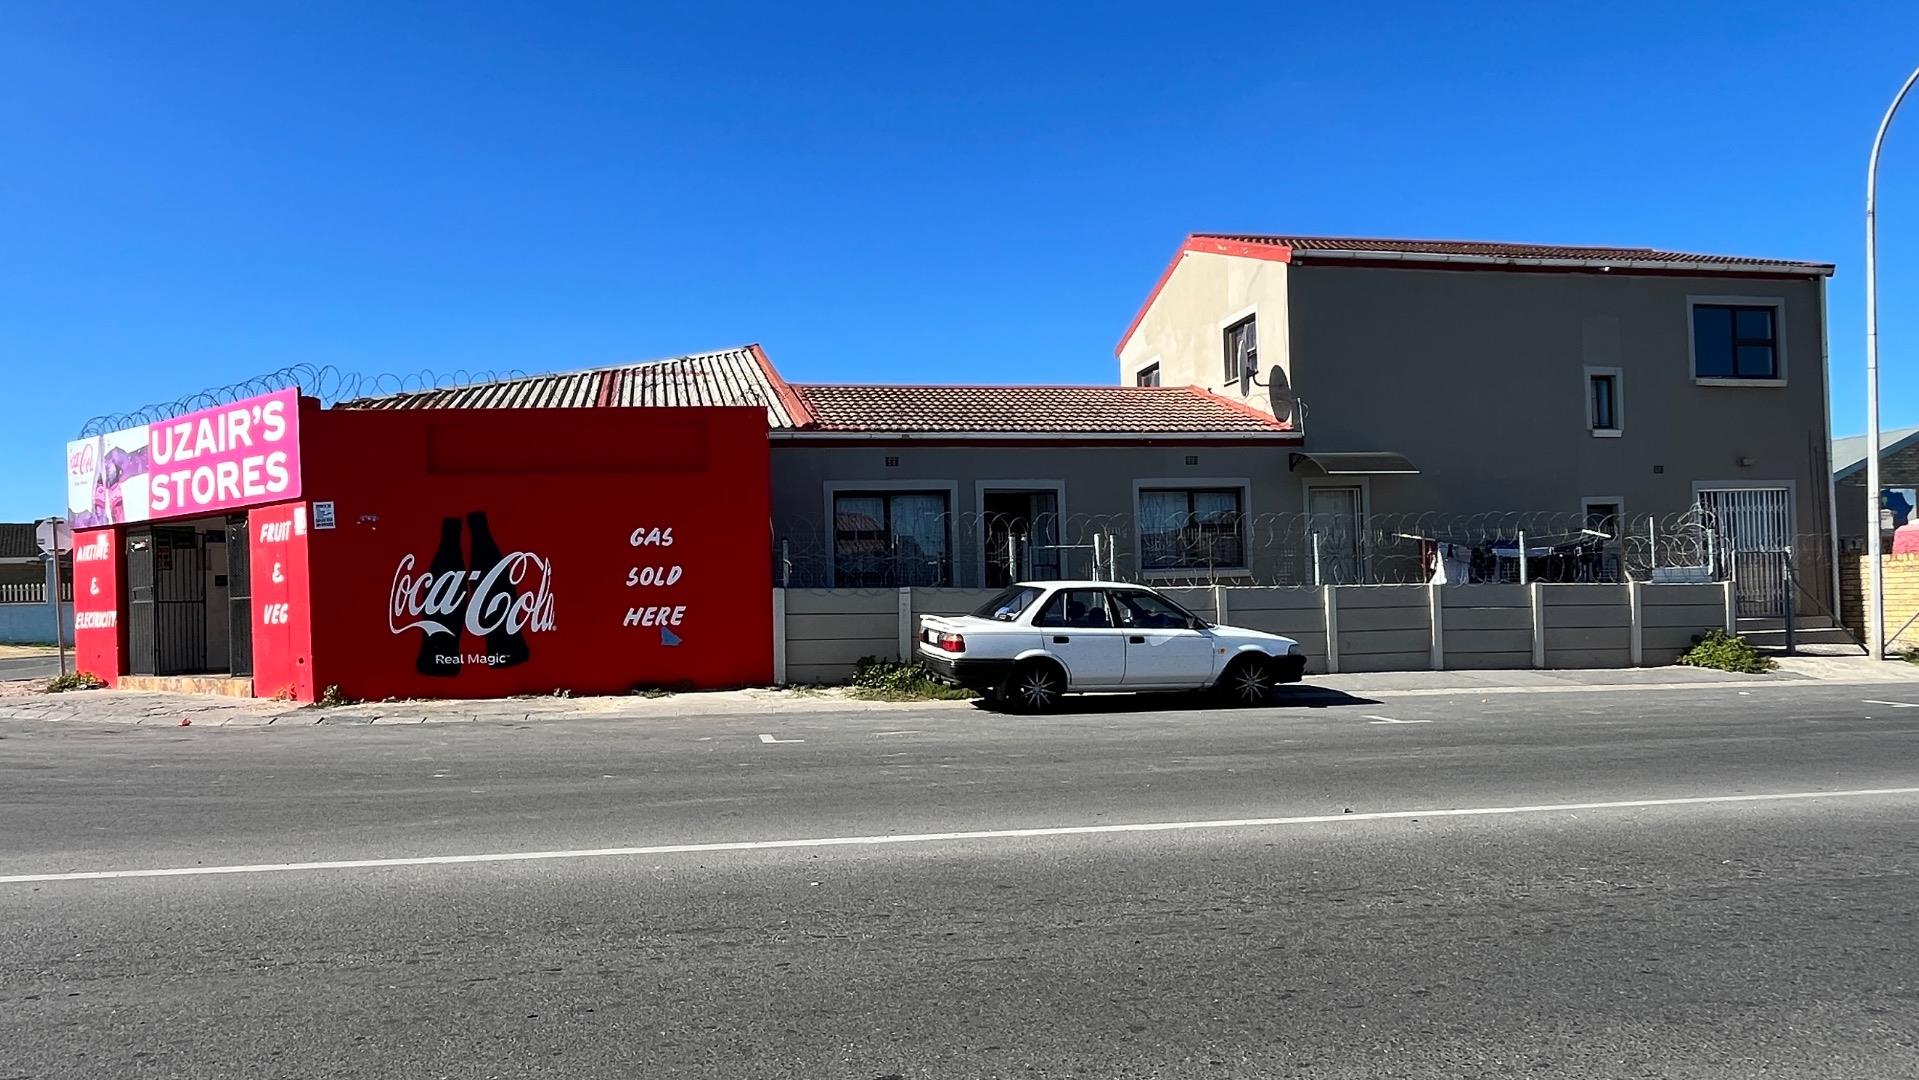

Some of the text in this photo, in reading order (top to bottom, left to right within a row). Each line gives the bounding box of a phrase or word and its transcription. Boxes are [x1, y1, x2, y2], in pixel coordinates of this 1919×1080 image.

[151, 400, 286, 466] UZAIR'S
[151, 451, 289, 511] STORES
[260, 520, 292, 543] FRUIT
[630, 527, 674, 547] GAS
[272, 562, 285, 584] &
[626, 565, 683, 587] SOLD
[90, 576, 100, 595] &
[389, 551, 556, 636] Coca-Cola
[263, 603, 289, 625] VEG
[623, 606, 687, 627] HERE
[435, 654, 465, 665] Real
